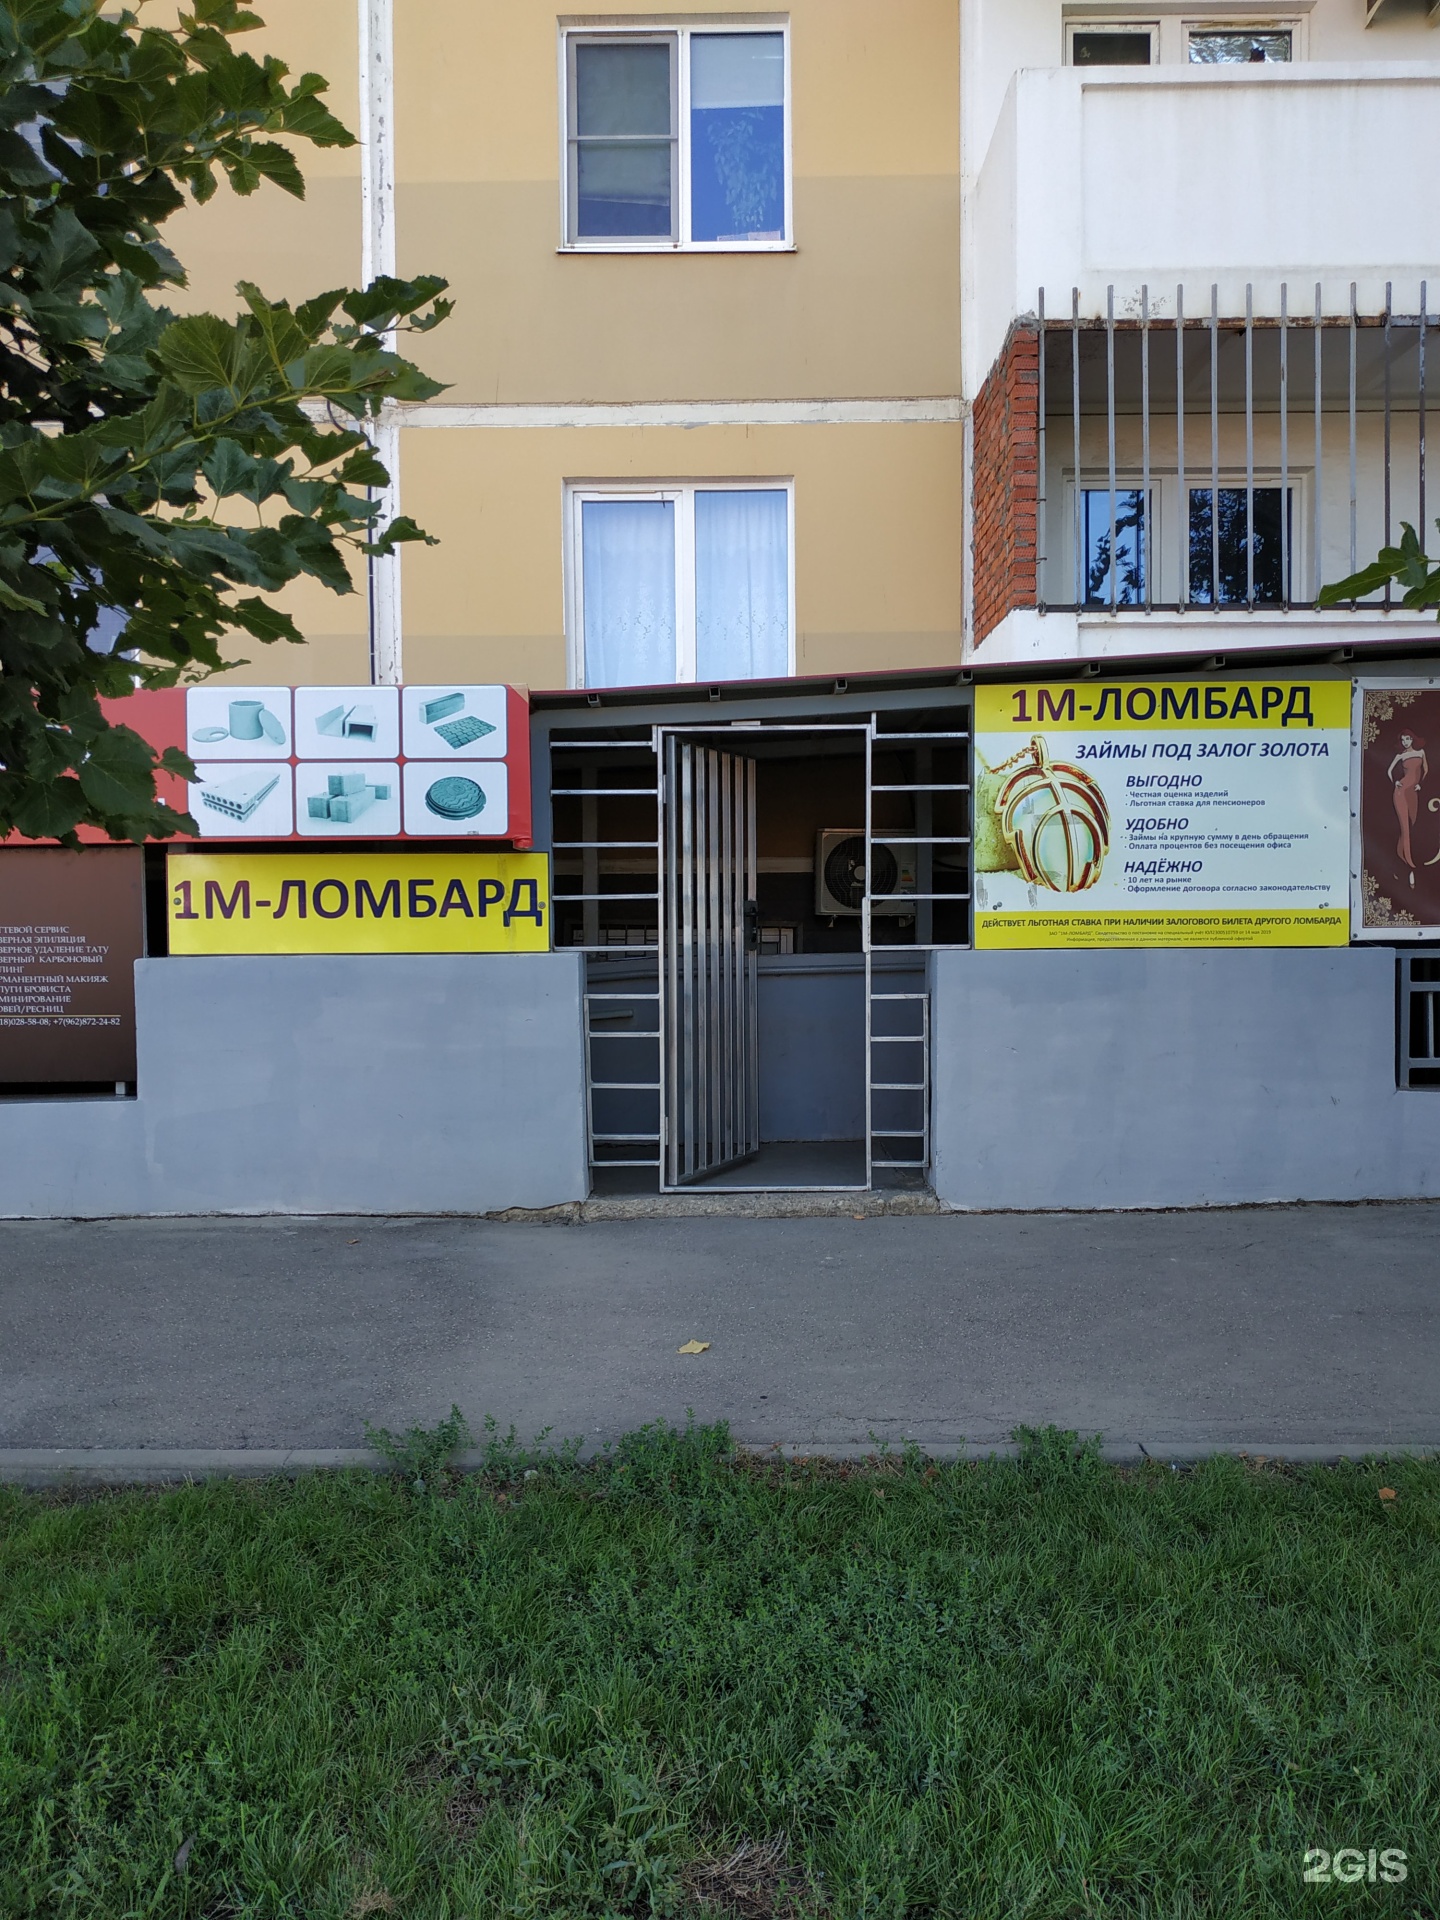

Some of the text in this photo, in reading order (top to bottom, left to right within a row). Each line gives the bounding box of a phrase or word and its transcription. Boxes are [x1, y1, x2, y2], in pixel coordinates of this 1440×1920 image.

[1011, 687, 1314, 727] 1М-ЛОМБАРД
[1075, 740, 1330, 761] ЗАЙМЫ ПОД ЗАЛОГ ЗОЛОТА
[1125, 775, 1203, 790] ВЫГОДНО
[1129, 789, 1229, 800] Честная оценка изделий
[1129, 800, 1166, 808] Льготная
[1195, 800, 1211, 808] для
[1212, 799, 1266, 808] пенсионеров
[1125, 818, 1189, 833] УДОБНО
[1128, 833, 1157, 842] Займы
[1158, 834, 1168, 842] на
[1169, 834, 1205, 843] крупную
[1207, 834, 1233, 843] сумму
[1241, 833, 1261, 842] день
[1263, 831, 1309, 842] обращения
[1128, 841, 1292, 852] Оплата процентов без посещения офиса
[1124, 858, 1203, 875] НАДЁЖНО
[1166, 877, 1192, 886] рынке
[1127, 884, 1331, 894] Оформление договора согласно законодательству
[173, 878, 543, 927] 1М-ЛОМБАРД
[982, 916, 1342, 929] ДЕЙСТВУЕТ ЛЬГОТНАЯ СТАВКА ПРИ НАЛИЧИИ ЗАЛОГОВОГО БИЛЕТА ДРУГОГО ЛОМБАРДА
[34, 925, 70, 934] СЕРВИС
[34, 936, 86, 945] ЭПИЛЯЦИЯ
[34, 946, 84, 954] УДАЛЕНИЕ
[86, 946, 109, 954] ТАТУ
[39, 955, 103, 963] КАРБОНОВЫЙ
[66, 975, 109, 983] МАКИЯЖ
[24, 985, 71, 993] БРОВИСТА
[53, 1018, 121, 1027] +7(962)872-24-82
